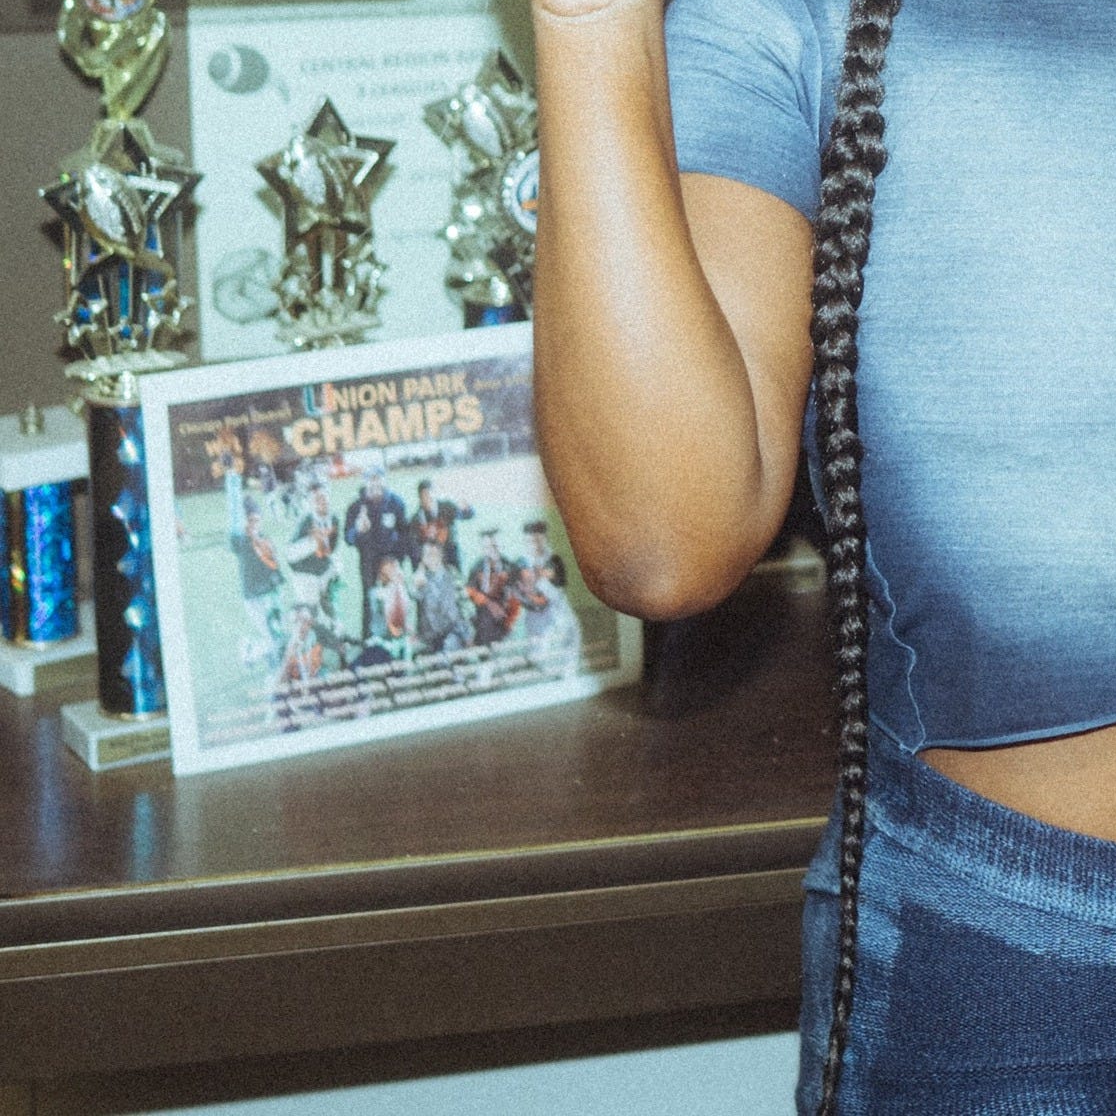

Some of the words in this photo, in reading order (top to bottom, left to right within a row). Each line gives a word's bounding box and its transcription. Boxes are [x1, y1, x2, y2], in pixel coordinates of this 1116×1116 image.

[303, 380, 398, 417] UNION
[402, 372, 468, 400] PARK
[290, 394, 485, 458] CHAMPS
